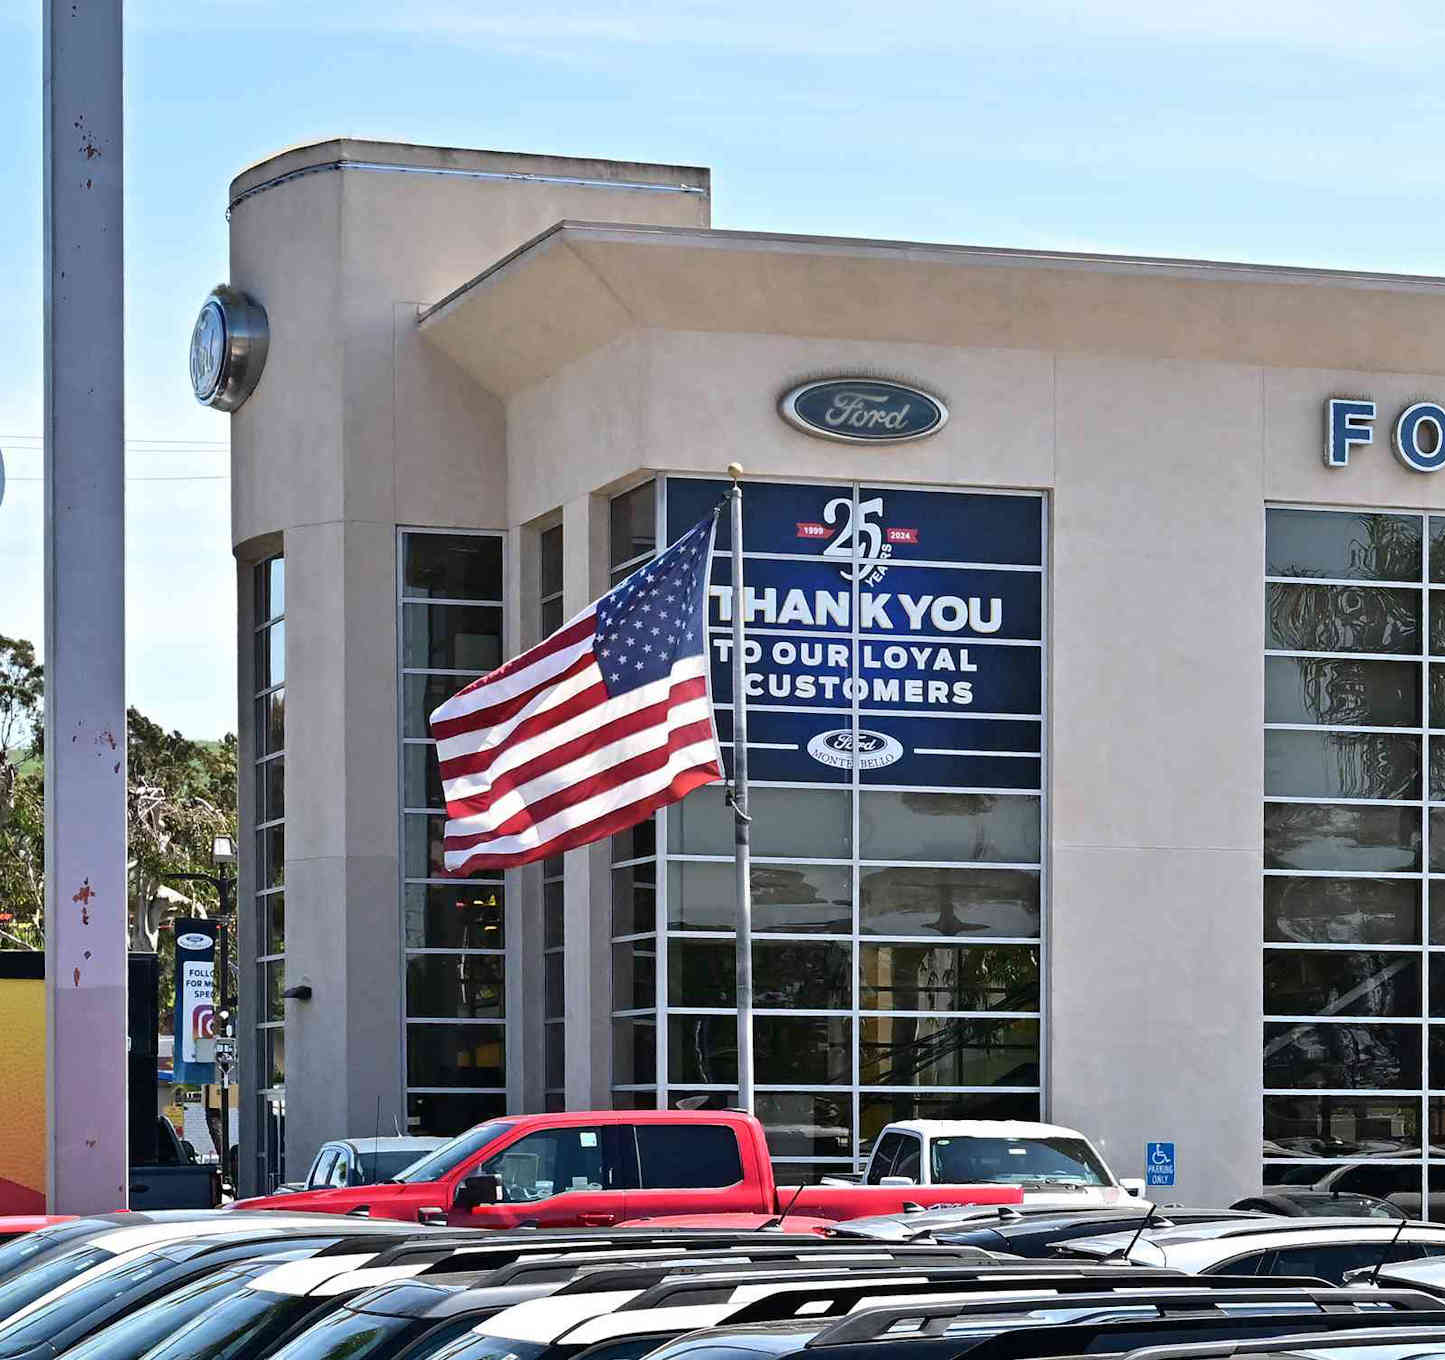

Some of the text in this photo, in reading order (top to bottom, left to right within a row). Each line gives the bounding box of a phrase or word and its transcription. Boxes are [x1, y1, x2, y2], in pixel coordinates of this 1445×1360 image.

[824, 391, 911, 430] Ford
[823, 497, 883, 581] 25
[865, 543, 892, 588] YEARS
[709, 585, 1002, 633] THANK YOU
[713, 639, 978, 673] TO OUR LOYAL
[744, 672, 974, 705] CUSTOMERS
[186, 980, 202, 988] FOR
[1152, 1175, 1169, 1184] ONLY
